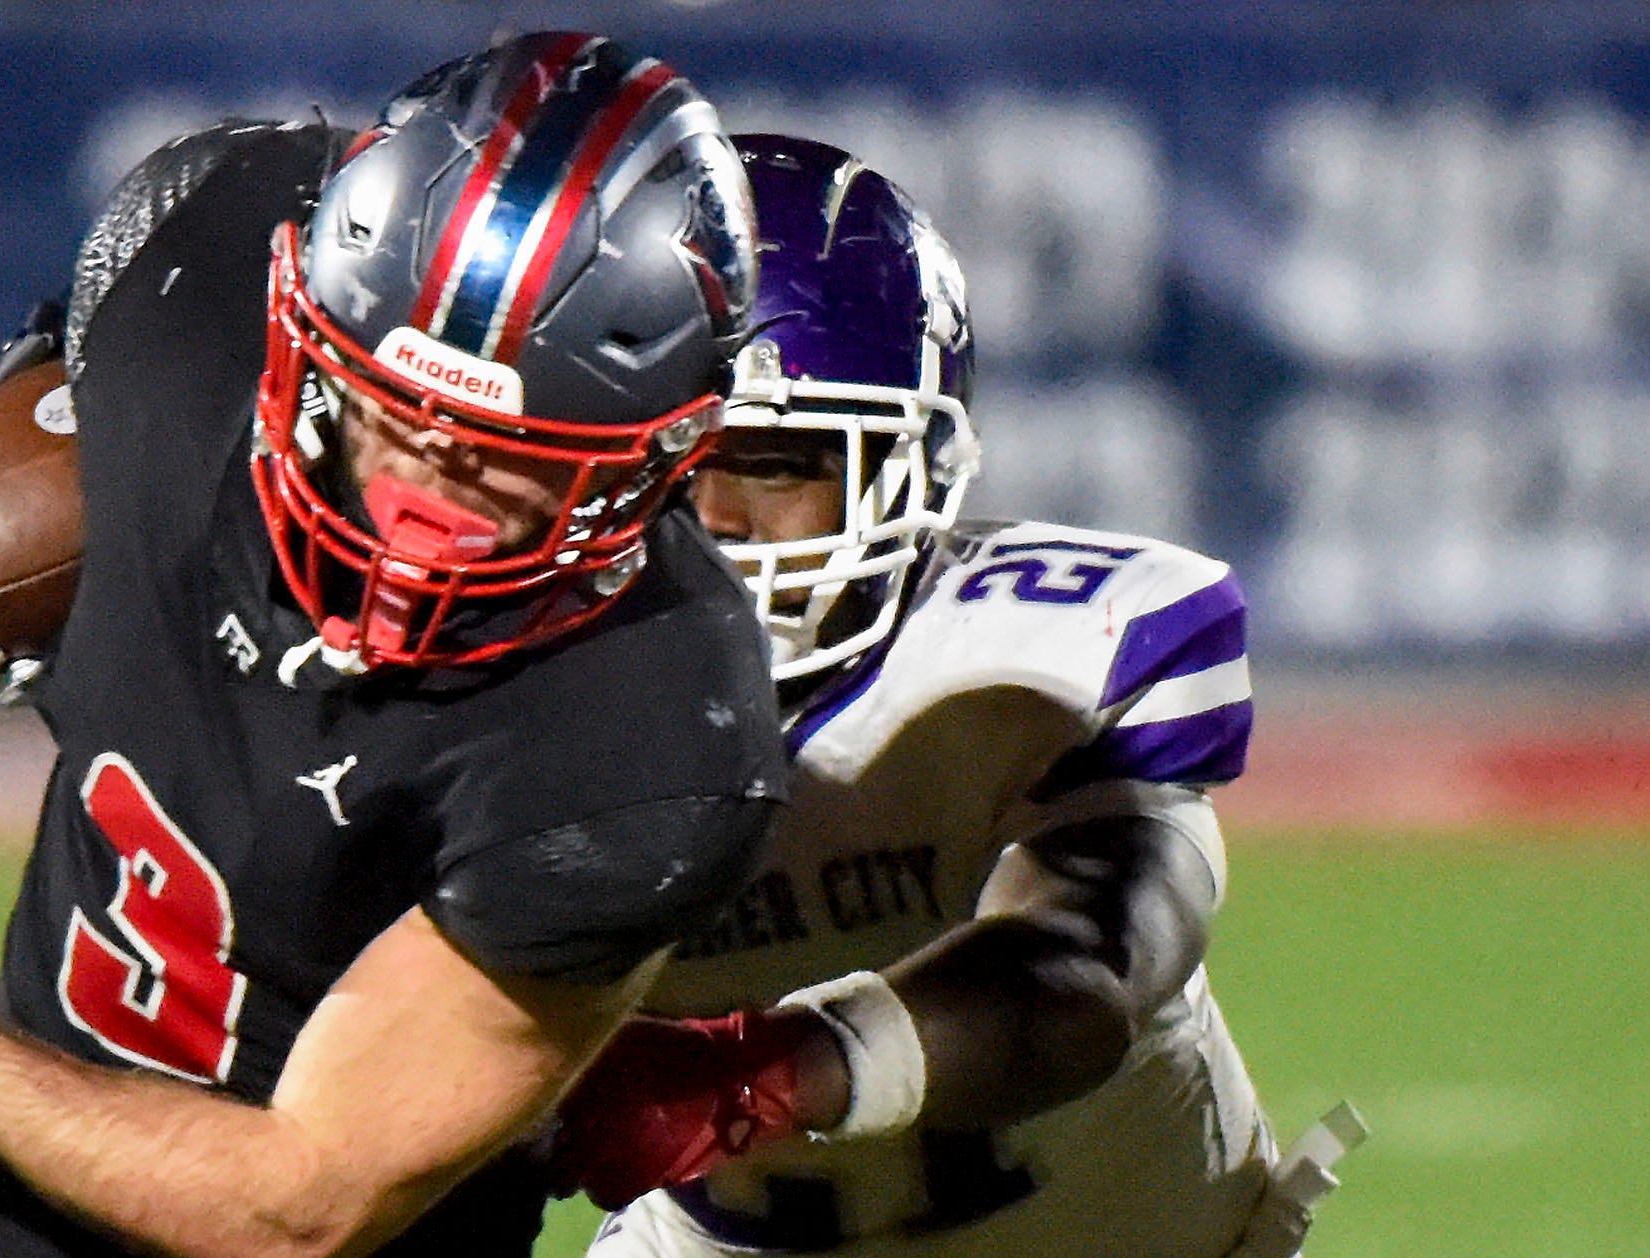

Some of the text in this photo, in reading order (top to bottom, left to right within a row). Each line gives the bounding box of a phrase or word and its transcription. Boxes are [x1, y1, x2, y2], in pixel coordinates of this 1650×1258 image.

[396, 344, 504, 399] Riddell
[955, 540, 1147, 605] 21
[58, 751, 248, 1085] 3
[820, 844, 944, 932] CITY
